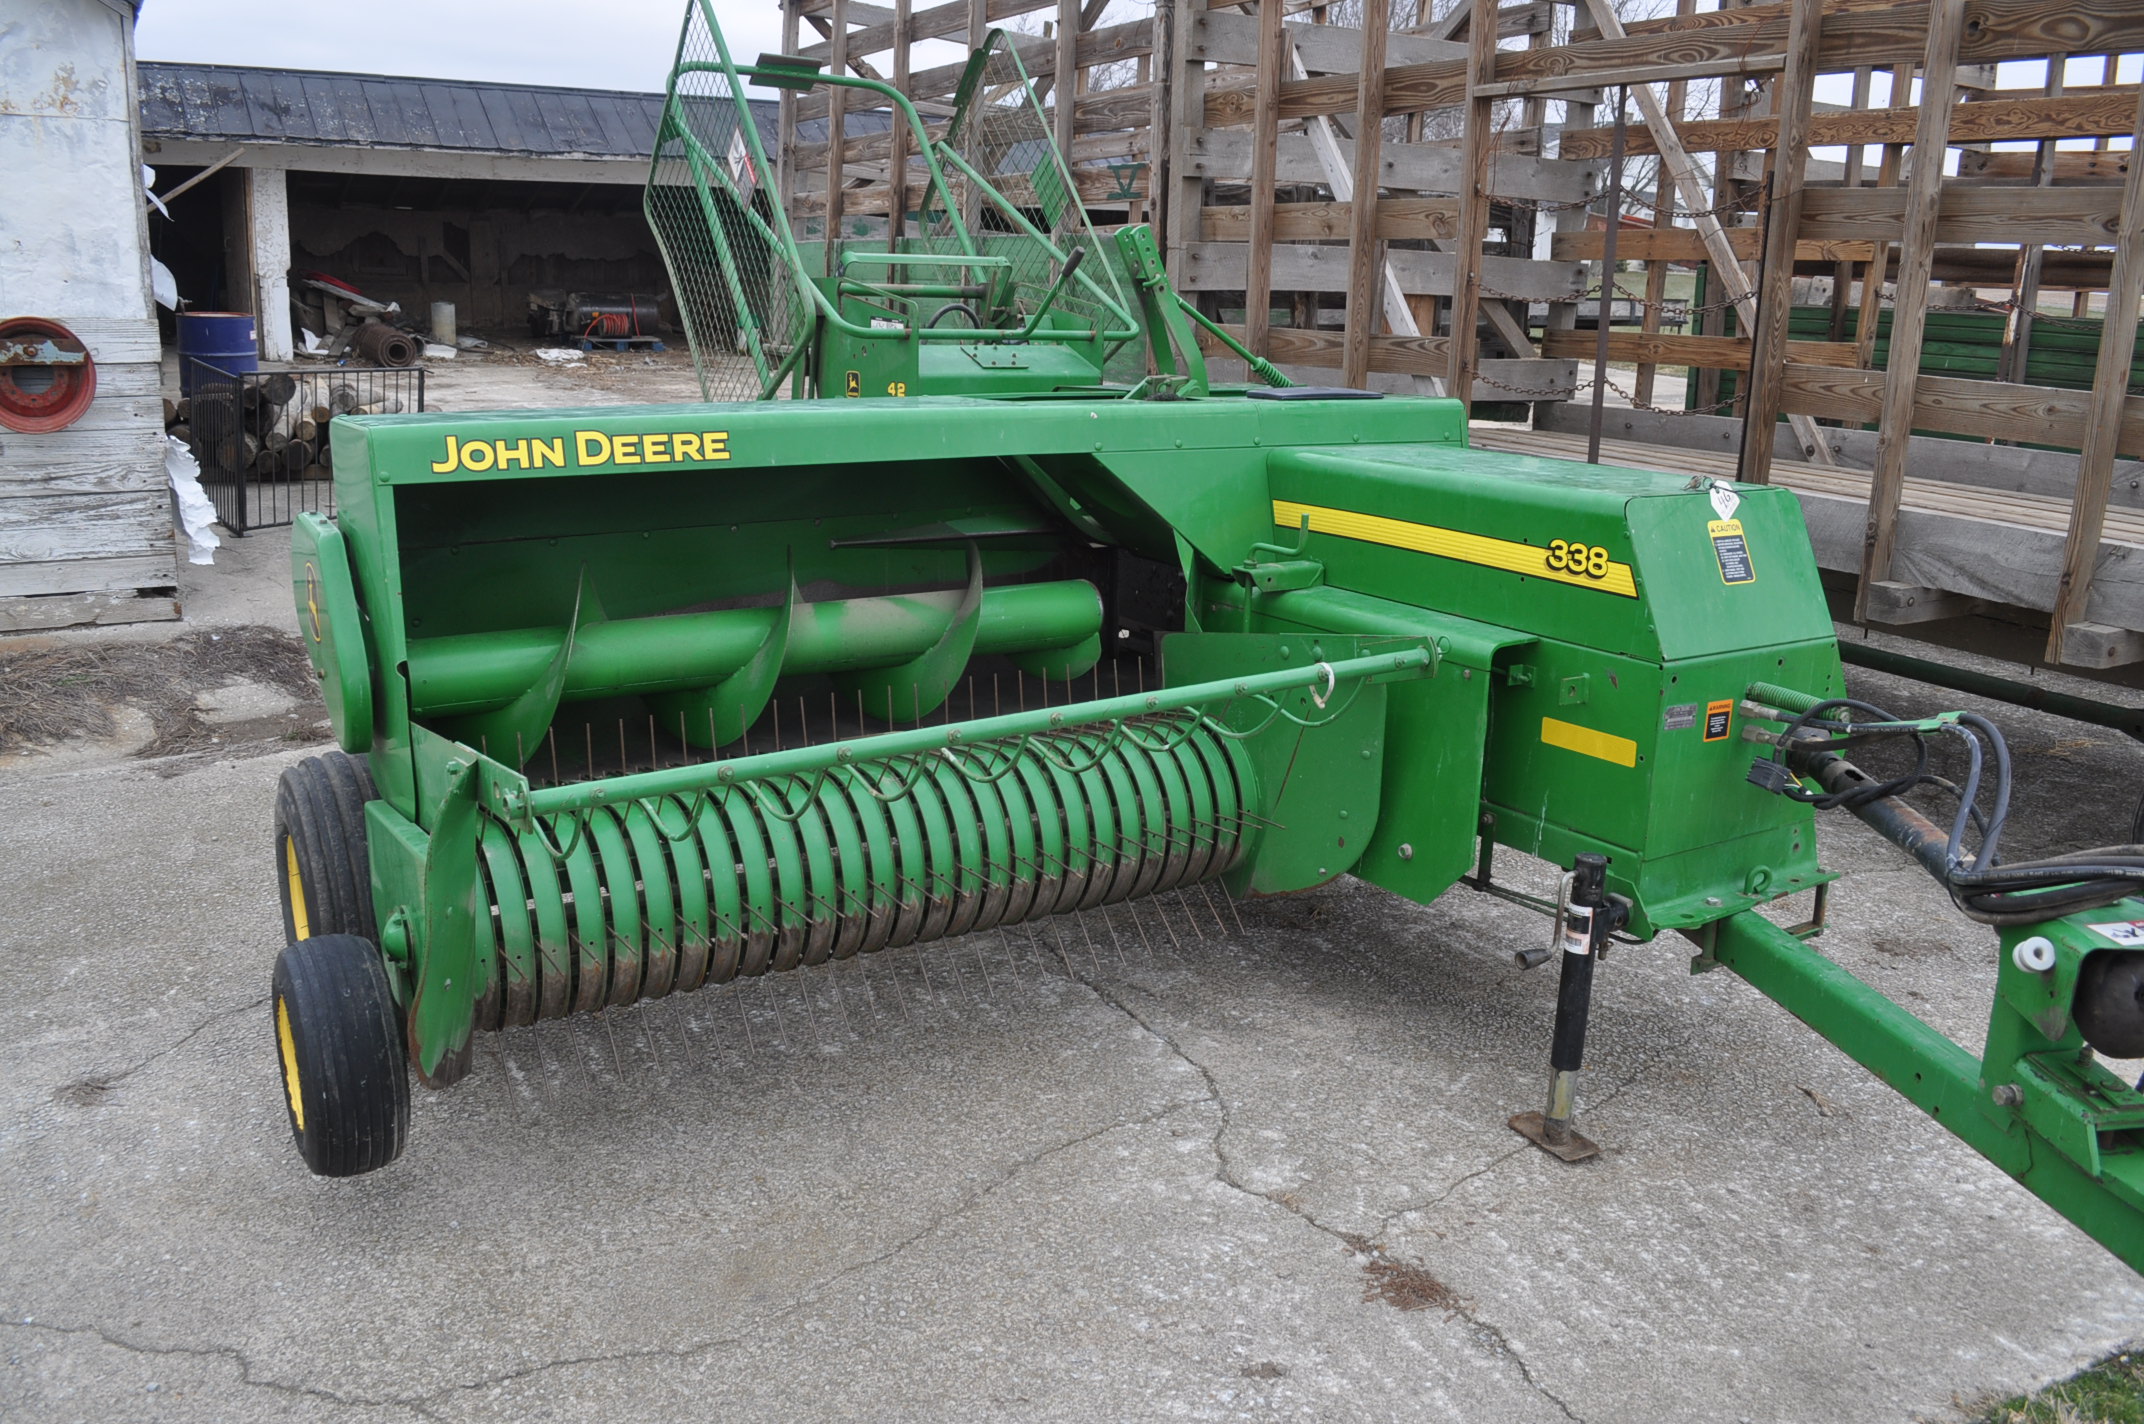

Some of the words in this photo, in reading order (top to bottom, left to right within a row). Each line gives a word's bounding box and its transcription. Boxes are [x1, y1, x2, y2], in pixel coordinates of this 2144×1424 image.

[887, 381, 906, 398] 42
[431, 435, 566, 474] JOHN
[574, 430, 731, 467] DEERE
[1716, 523, 1740, 533] CAUTION
[1546, 538, 1609, 579] 338
